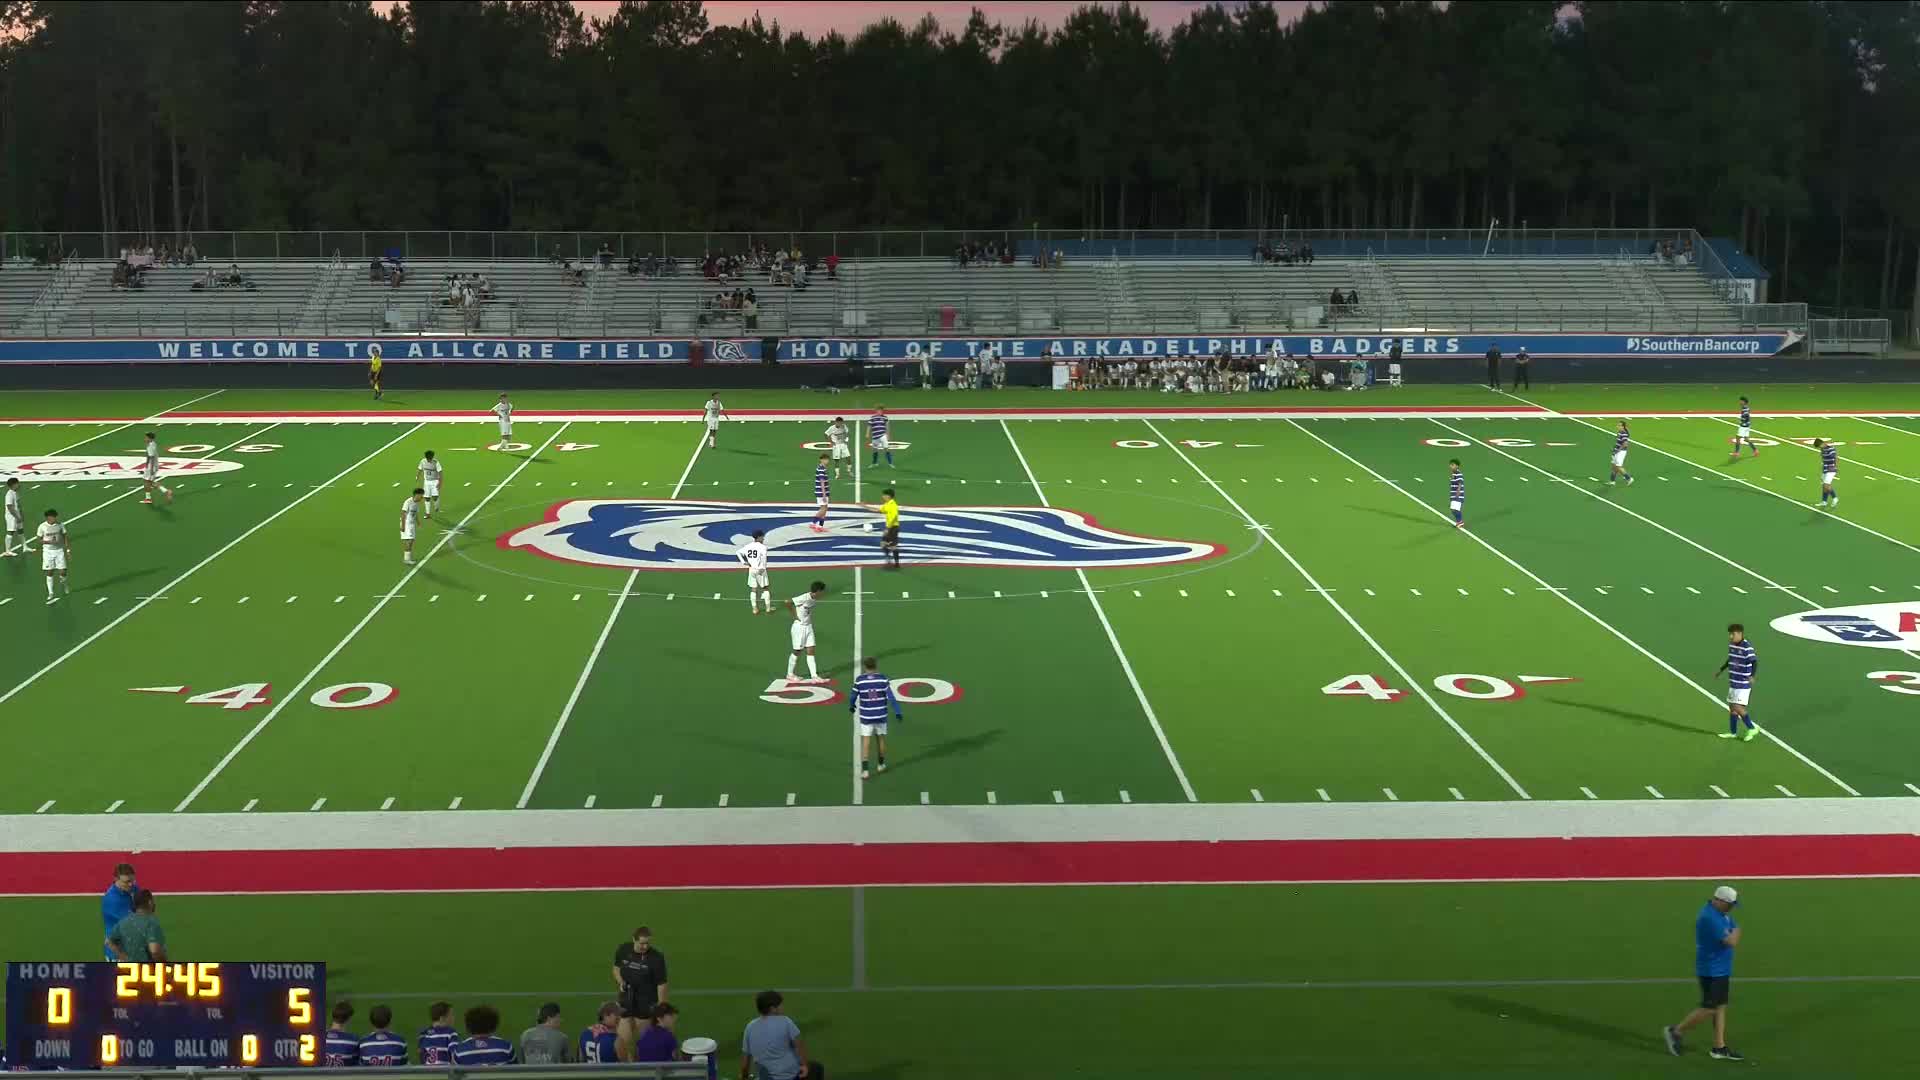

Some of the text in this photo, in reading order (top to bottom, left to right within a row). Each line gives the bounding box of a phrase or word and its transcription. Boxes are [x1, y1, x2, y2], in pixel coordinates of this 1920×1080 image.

[159, 343, 673, 358] WELCOME TO ALLCARE FIELD
[791, 338, 1459, 357] HOME OF THE ARKADELPHIA BADGERS
[747, 549, 758, 559] 29
